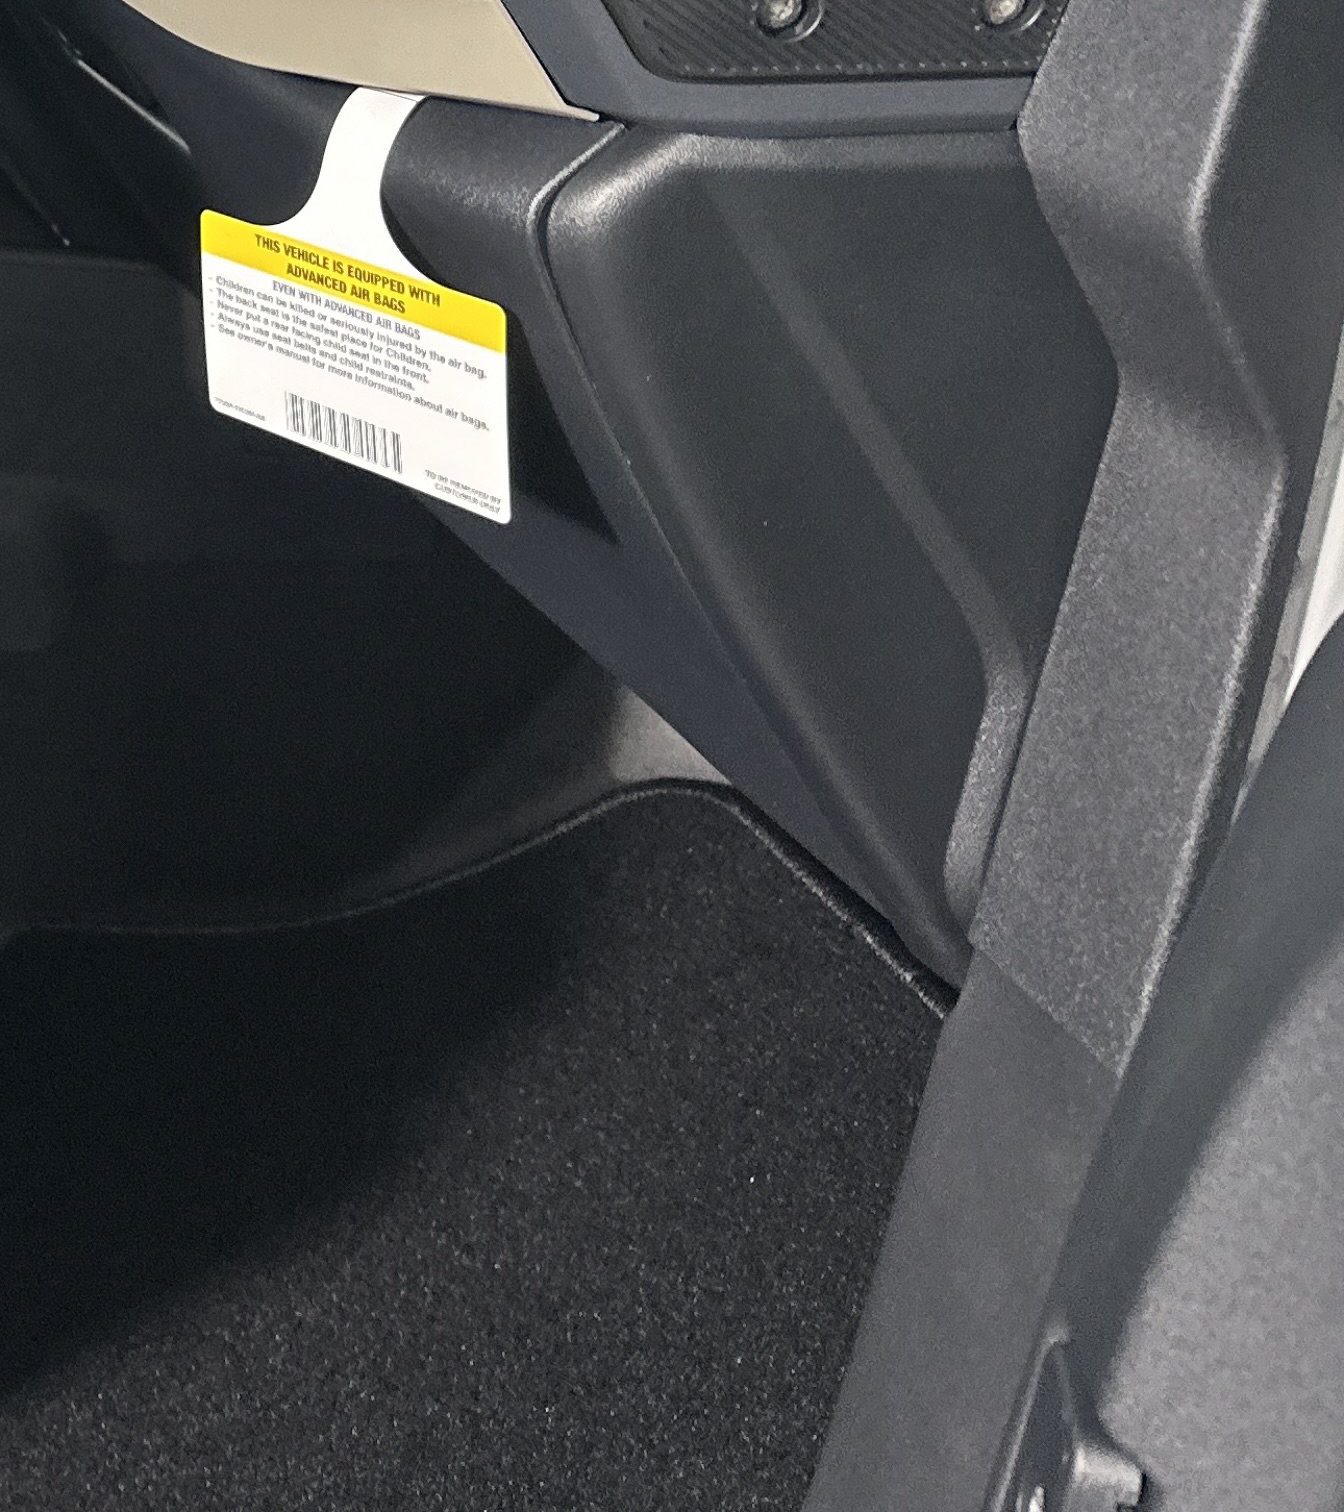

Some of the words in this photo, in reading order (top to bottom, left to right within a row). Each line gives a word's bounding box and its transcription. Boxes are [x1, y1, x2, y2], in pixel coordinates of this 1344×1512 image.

[255, 233, 280, 253] THIS
[283, 243, 330, 270] VEHICLE
[333, 259, 344, 275] IS
[347, 265, 405, 294] EQUIPPED
[408, 284, 440, 307] WITH
[286, 263, 347, 293] ADVANCED
[350, 285, 370, 302] AIR
[374, 292, 405, 314] BAGS
[216, 287, 233, 301] The
[235, 295, 257, 309] back
[260, 305, 279, 317] seat
[282, 311, 290, 321] is
[292, 314, 307, 327] the
[309, 322, 338, 338] safest
[341, 333, 367, 348] place
[370, 342, 384, 354] for
[216, 276, 254, 296] Children
[256, 291, 273, 302] can
[276, 297, 287, 308] be
[290, 302, 315, 318] killed
[317, 313, 327, 322] or
[330, 316, 375, 339] seriously
[377, 331, 412, 352] injured
[415, 344, 427, 358] by
[429, 350, 445, 364] the
[448, 358, 462, 370] air
[464, 362, 487, 380] bag.
[217, 300, 243, 317] Never
[246, 311, 261, 324] put
[292, 326, 321, 346] facing
[323, 338, 347, 354] child
[349, 348, 369, 361] seat
[372, 355, 382, 367] in
[384, 360, 400, 372] the
[272, 280, 296, 297] EVEN
[298, 289, 322, 306] WITH
[324, 298, 372, 323] ADVANCED
[376, 317, 392, 330] AIR
[395, 322, 421, 341] BAGS
[218, 323, 235, 337] See
[312, 357, 326, 369] for
[354, 373, 412, 401] information
[414, 395, 443, 414] about
[444, 408, 459, 419] air
[319, 349, 337, 362] and
[339, 356, 363, 372] child
